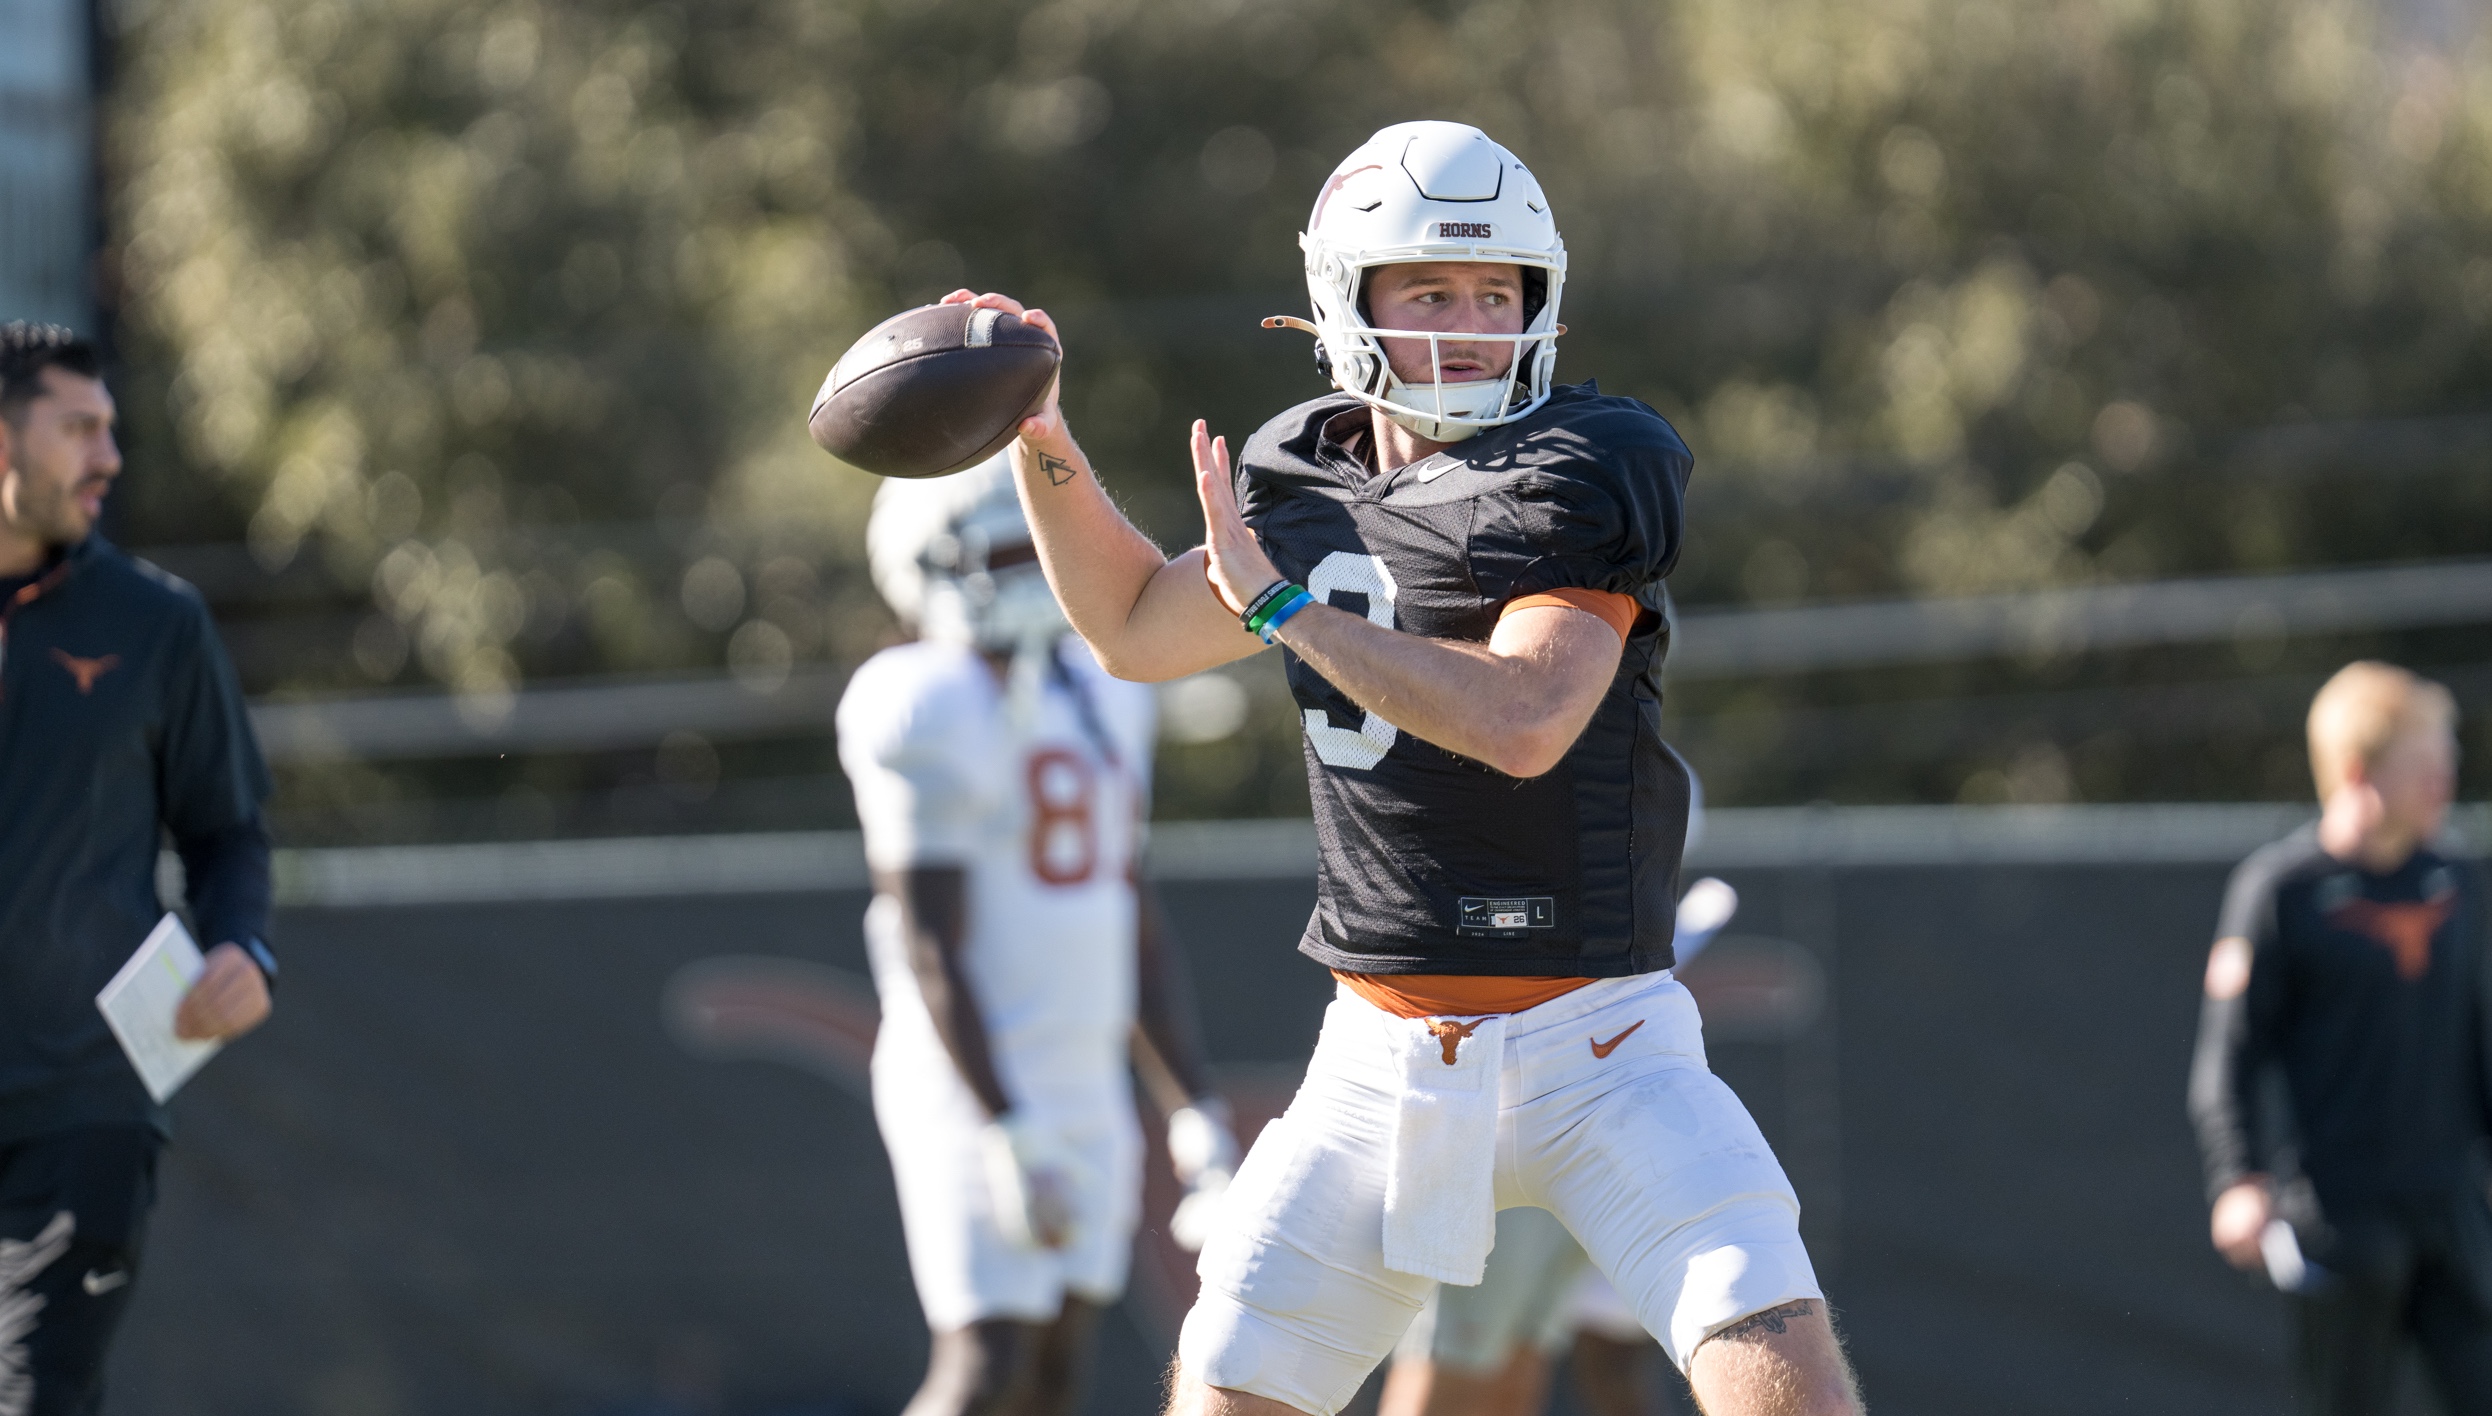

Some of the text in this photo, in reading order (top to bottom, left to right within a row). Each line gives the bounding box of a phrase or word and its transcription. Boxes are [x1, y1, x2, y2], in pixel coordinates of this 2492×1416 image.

[1439, 223, 1491, 238] HORNS
[1245, 594, 1270, 617] FOOTBALL
[1513, 915, 1525, 924] 26
[1536, 906, 1544, 919] L
